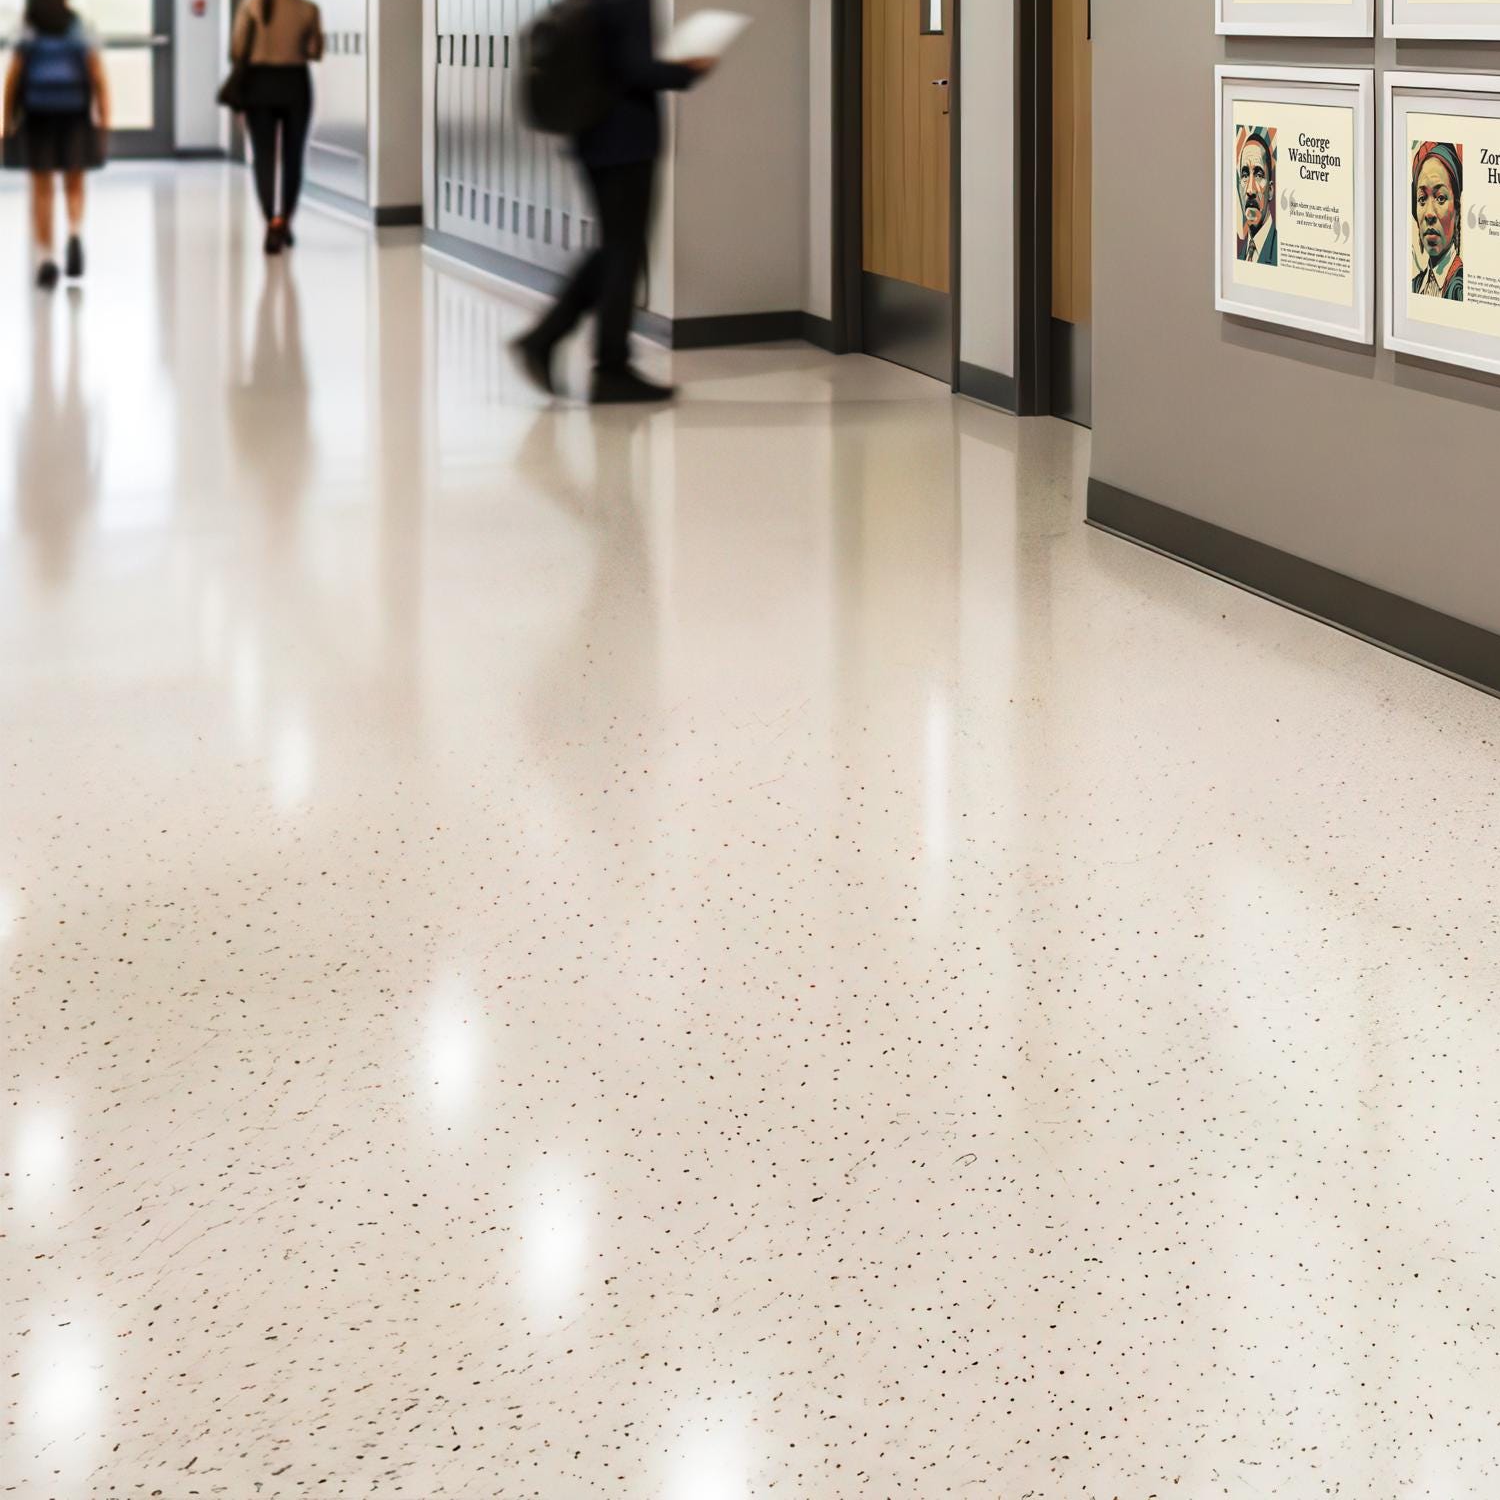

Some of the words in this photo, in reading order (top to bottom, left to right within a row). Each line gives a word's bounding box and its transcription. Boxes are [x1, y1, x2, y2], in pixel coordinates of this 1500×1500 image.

[1298, 132, 1329, 153] George
[1288, 147, 1340, 169] Washington
[1299, 165, 1329, 182] Carver
